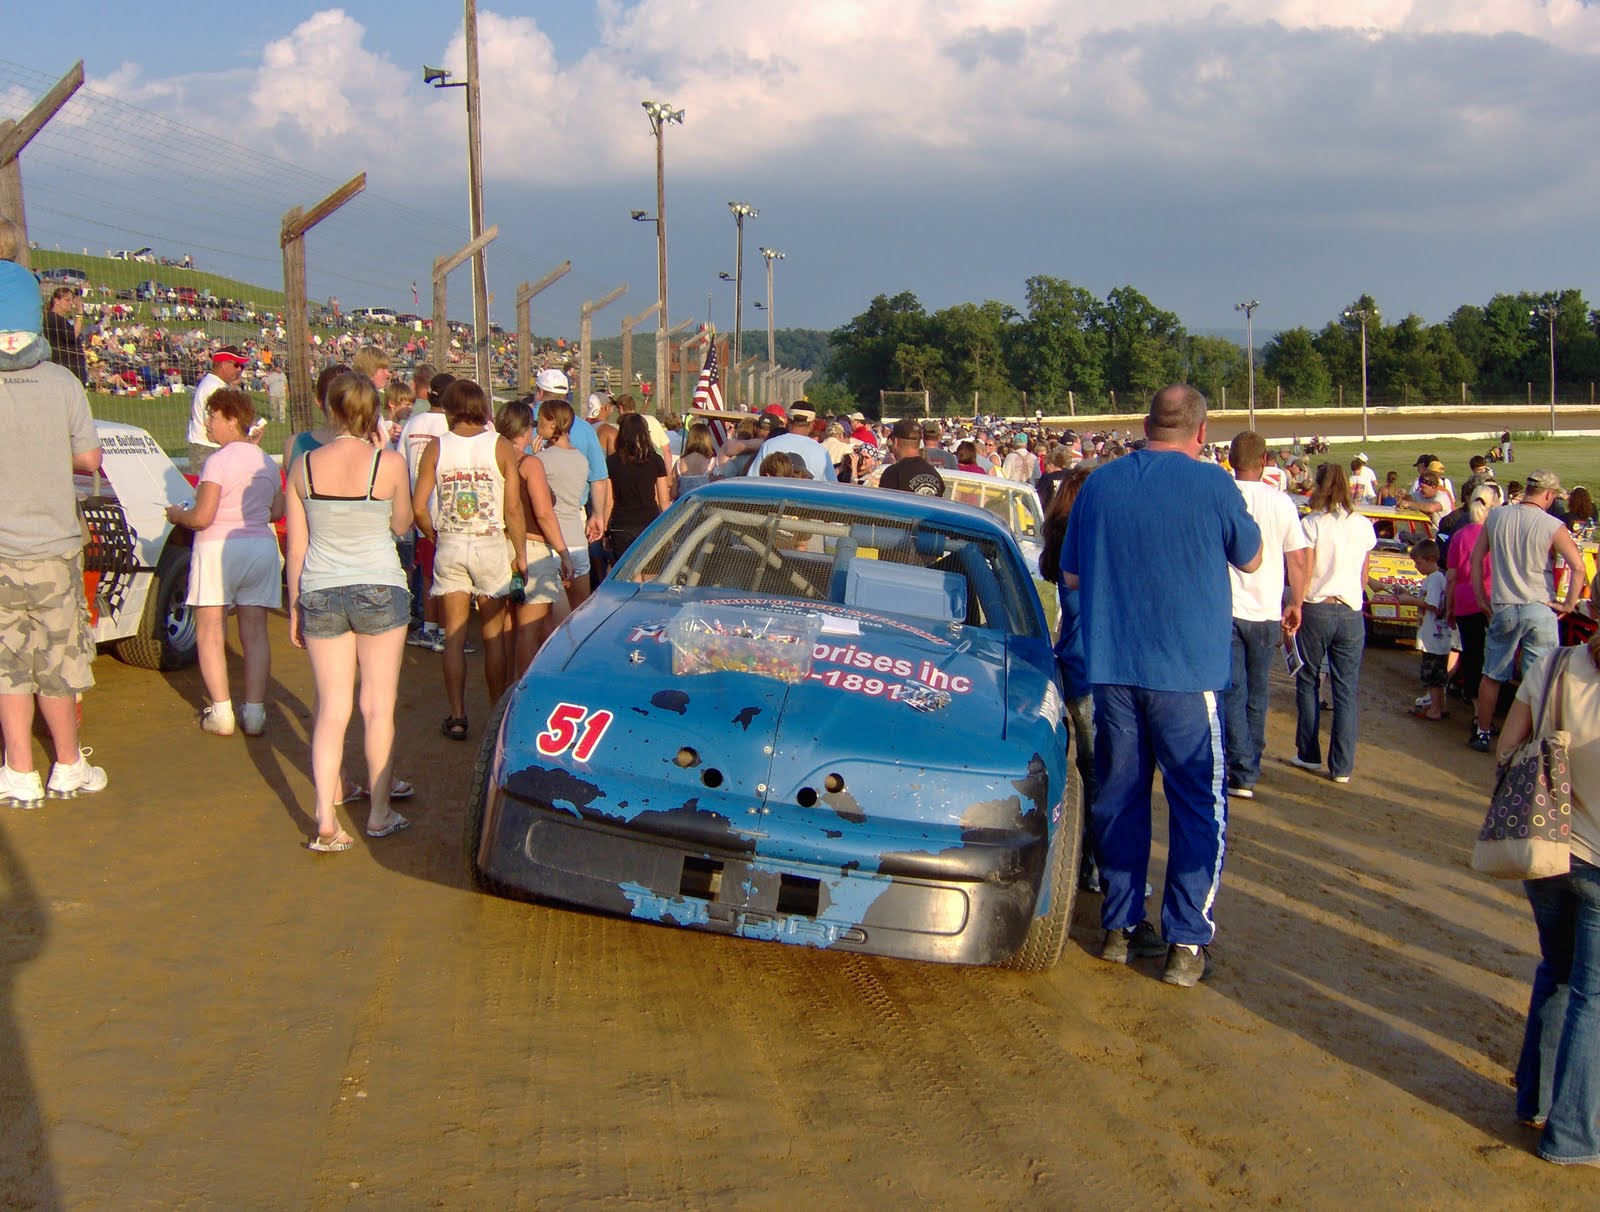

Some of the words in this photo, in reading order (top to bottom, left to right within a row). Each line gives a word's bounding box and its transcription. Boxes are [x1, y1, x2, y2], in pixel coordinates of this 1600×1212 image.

[115, 435, 146, 447] Building
[771, 604, 803, 612] May
[536, 702, 614, 763] 51
